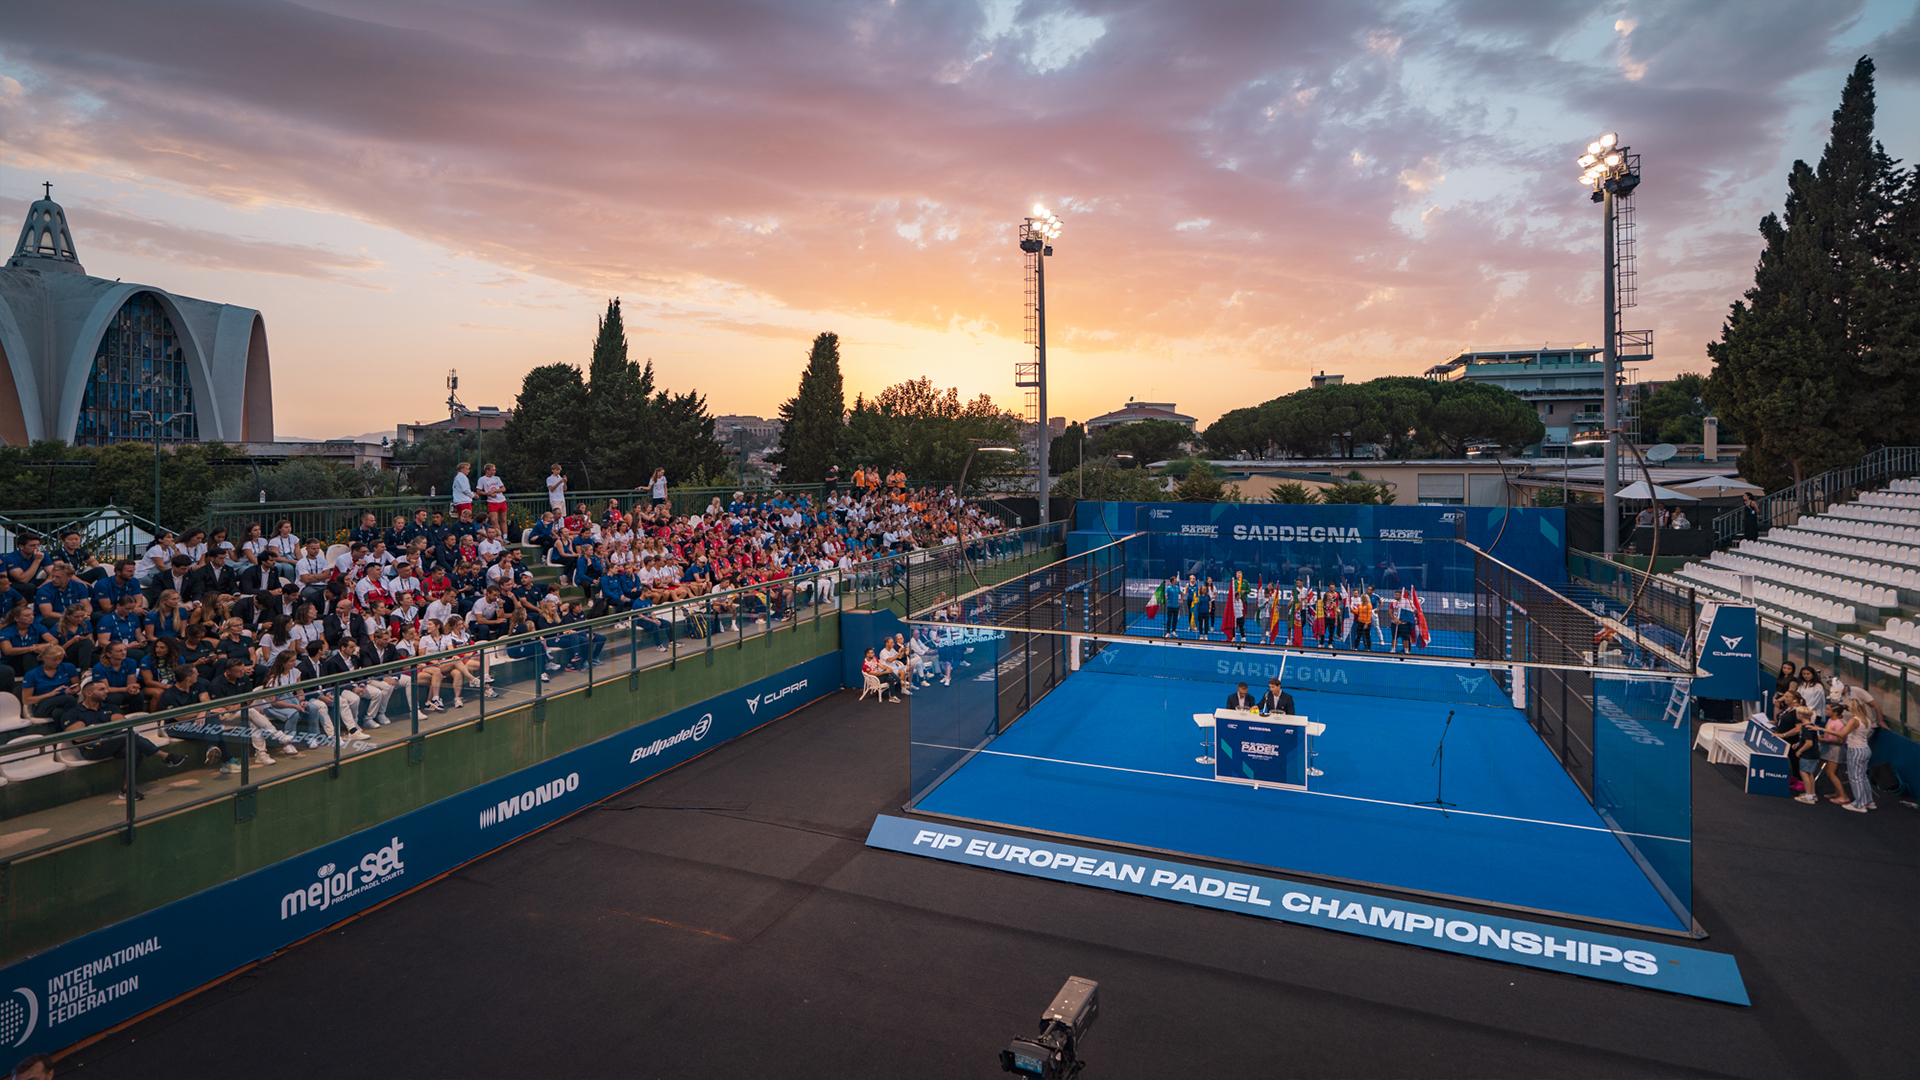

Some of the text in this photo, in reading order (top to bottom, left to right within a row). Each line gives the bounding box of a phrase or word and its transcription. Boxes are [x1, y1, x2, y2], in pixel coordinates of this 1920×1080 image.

[1233, 524, 1362, 544] SARDEGNA
[1217, 659, 1348, 685] SARDEGNA
[763, 679, 808, 704] CUPRA
[629, 724, 696, 764] Bullpadel
[1241, 744, 1278, 754] PADEL
[497, 772, 580, 823] MONDO
[331, 868, 405, 905] PREMIUM PADEL COURTS
[912, 829, 1659, 976] FIP EUROPEAN PADEL CHAMPIONSHIPS
[48, 936, 162, 982] INTERNATIONAL
[48, 979, 97, 1011] PADEL
[48, 974, 139, 1028] FEDERATION
